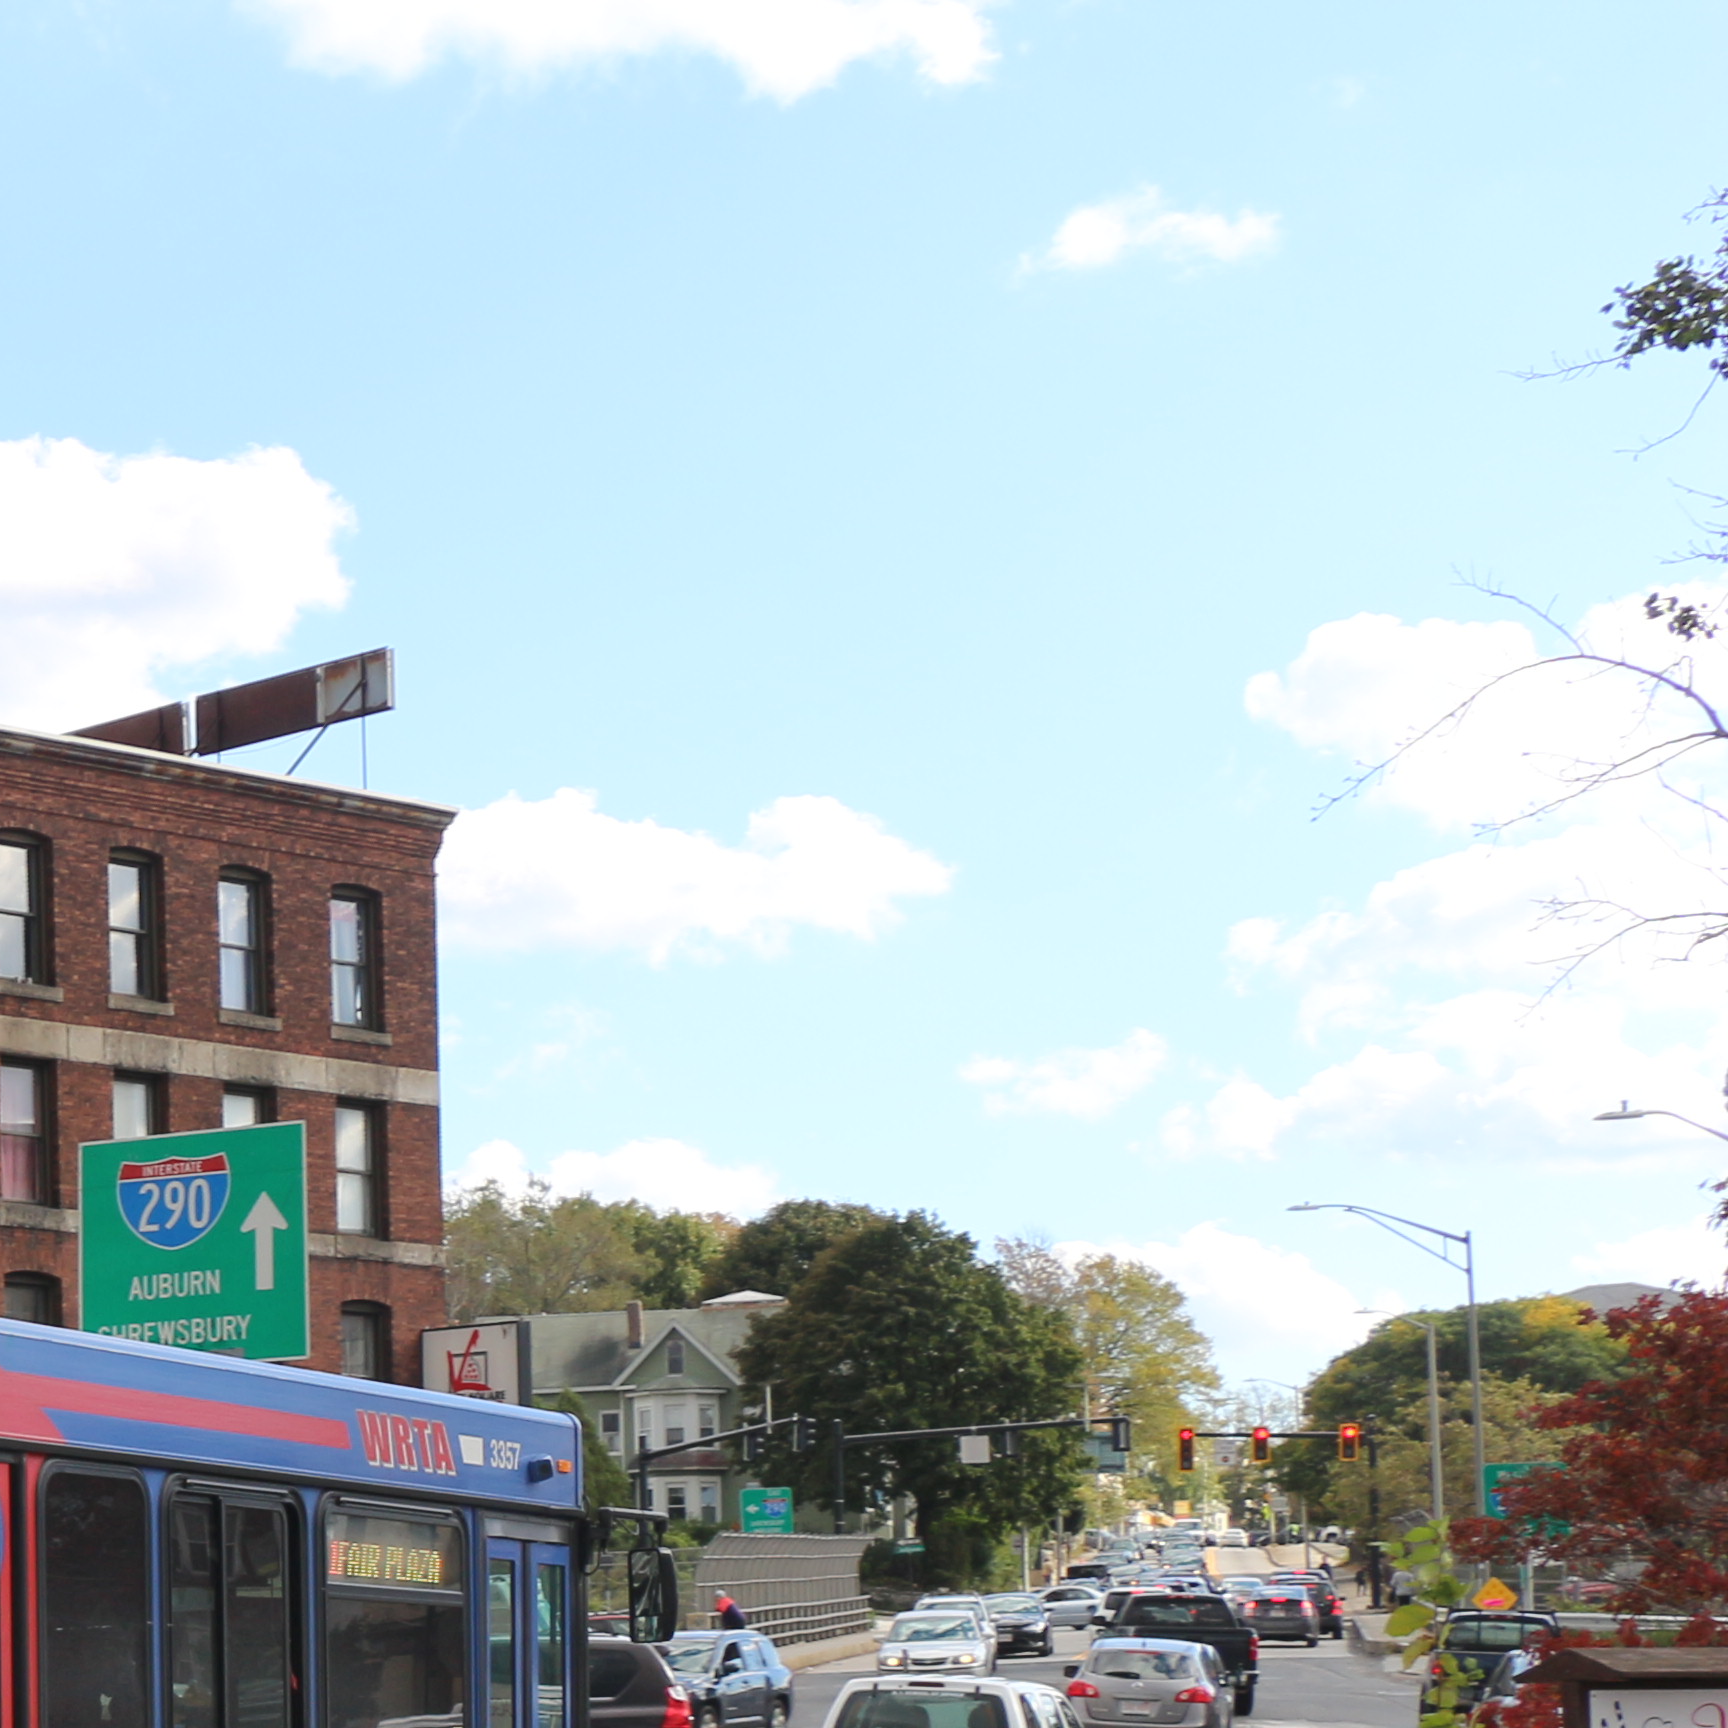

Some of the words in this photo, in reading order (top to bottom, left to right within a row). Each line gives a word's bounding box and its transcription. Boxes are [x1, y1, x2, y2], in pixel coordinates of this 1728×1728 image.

[142, 1160, 204, 1177] INTERSTATE
[138, 1178, 211, 1233] 290
[129, 1269, 221, 1301] AUBURN
[356, 1409, 458, 1477] WRTA
[490, 1439, 522, 1471] 3357
[384, 1546, 440, 1584] PLAZA
